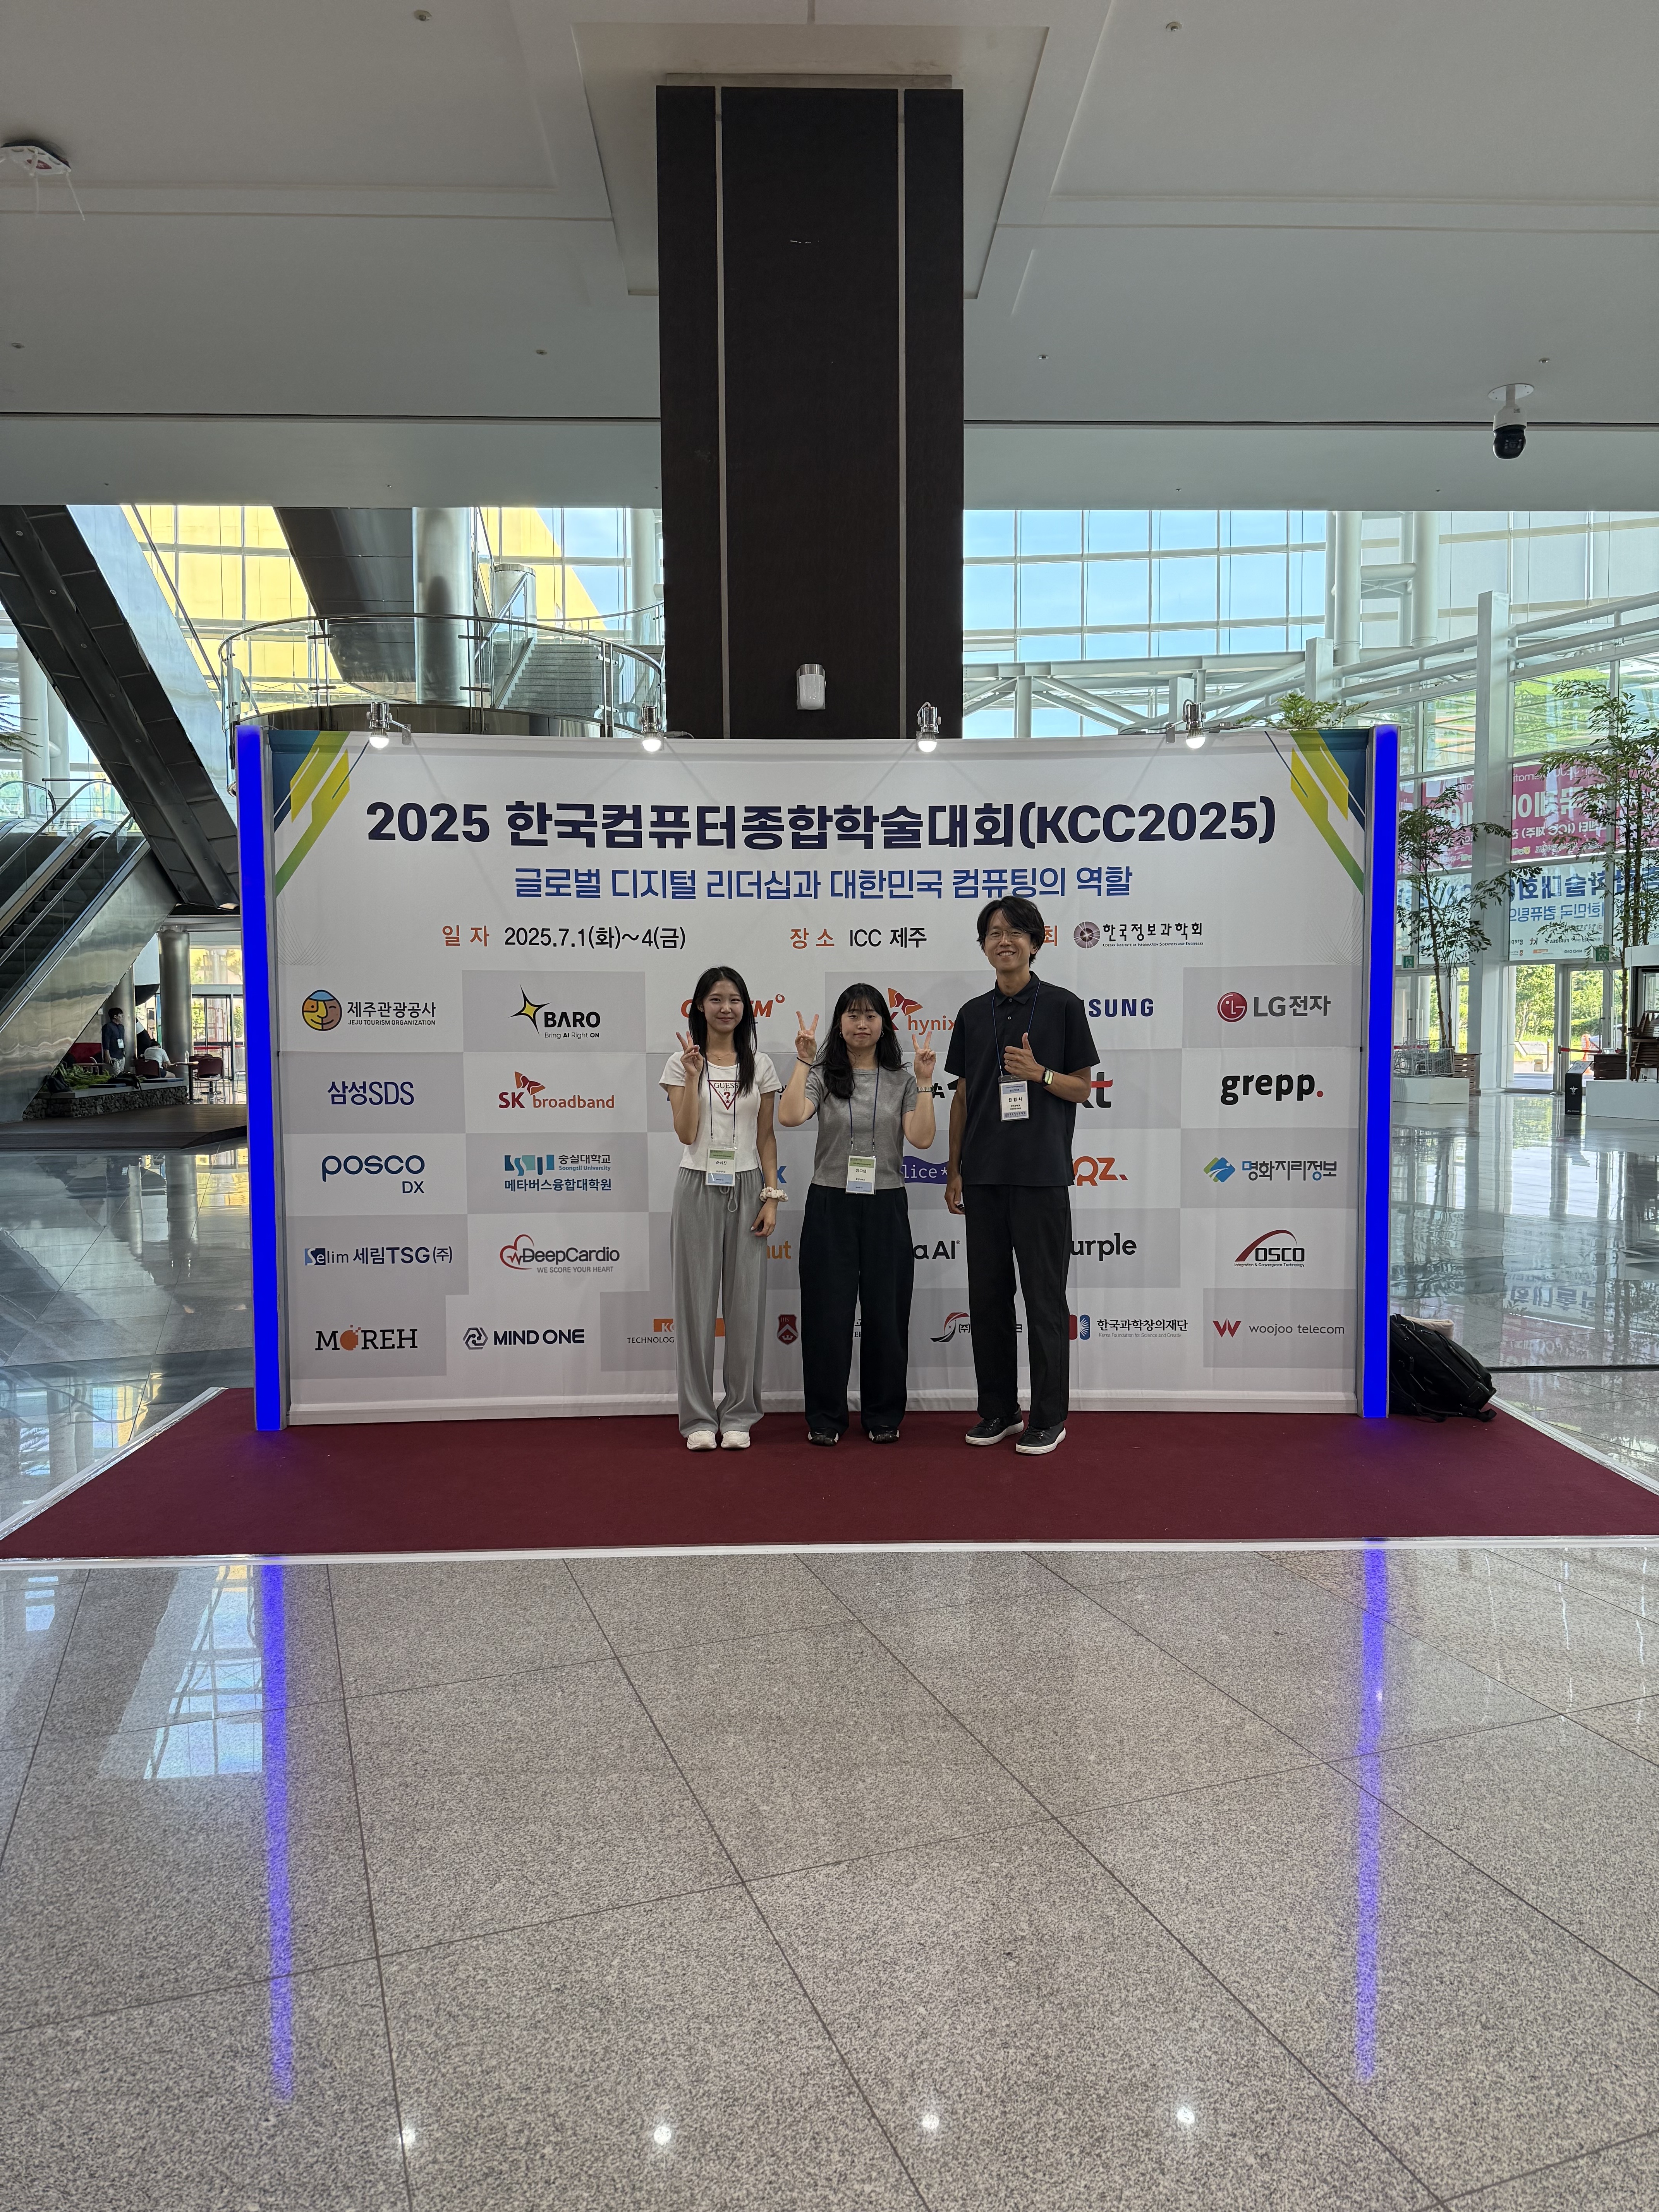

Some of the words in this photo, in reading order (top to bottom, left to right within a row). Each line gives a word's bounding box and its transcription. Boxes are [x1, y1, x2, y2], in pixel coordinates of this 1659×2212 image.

[367, 802, 489, 842] 2025
[506, 796, 1275, 850] 한국컴퓨터종합학술대회(KCC2025)
[515, 868, 601, 898] 글로벌
[612, 869, 696, 900] 디지털
[707, 870, 821, 900] 리더십과
[830, 869, 943, 899] 대한민국
[952, 867, 1066, 898] 컴퓨팅의
[1076, 866, 1132, 897] 역할
[505, 926, 685, 950] 2025.7.1(화)~4(금)
[850, 929, 882, 947] ICC
[890, 927, 927, 948] 제주
[1103, 922, 1202, 941] 한국정보과학회
[347, 1001, 436, 1018] 제주관광공사
[1254, 996, 1331, 1017] LG전자
[544, 1011, 601, 1028] BARO
[328, 1081, 414, 1106] 삼성SDS
[1220, 1073, 1324, 1106] grepp.
[498, 1092, 525, 1109] SK
[532, 1095, 615, 1109] broadband
[558, 1154, 611, 1164] 숭실대학교
[322, 1155, 425, 1182] posco
[1242, 1161, 1337, 1181] 명화지리정보
[402, 1181, 424, 1194] DX
[505, 1179, 611, 1192] 메타버스융합대학원
[305, 1248, 349, 1266] Selim
[522, 1247, 620, 1265] DeepCardio
[1096, 1319, 1189, 1331] 한국과학창의재단
[1249, 1324, 1293, 1336] woojoo
[1297, 1324, 1345, 1334] telecom
[494, 1330, 539, 1345] MIND
[543, 1329, 584, 1345] ONE
